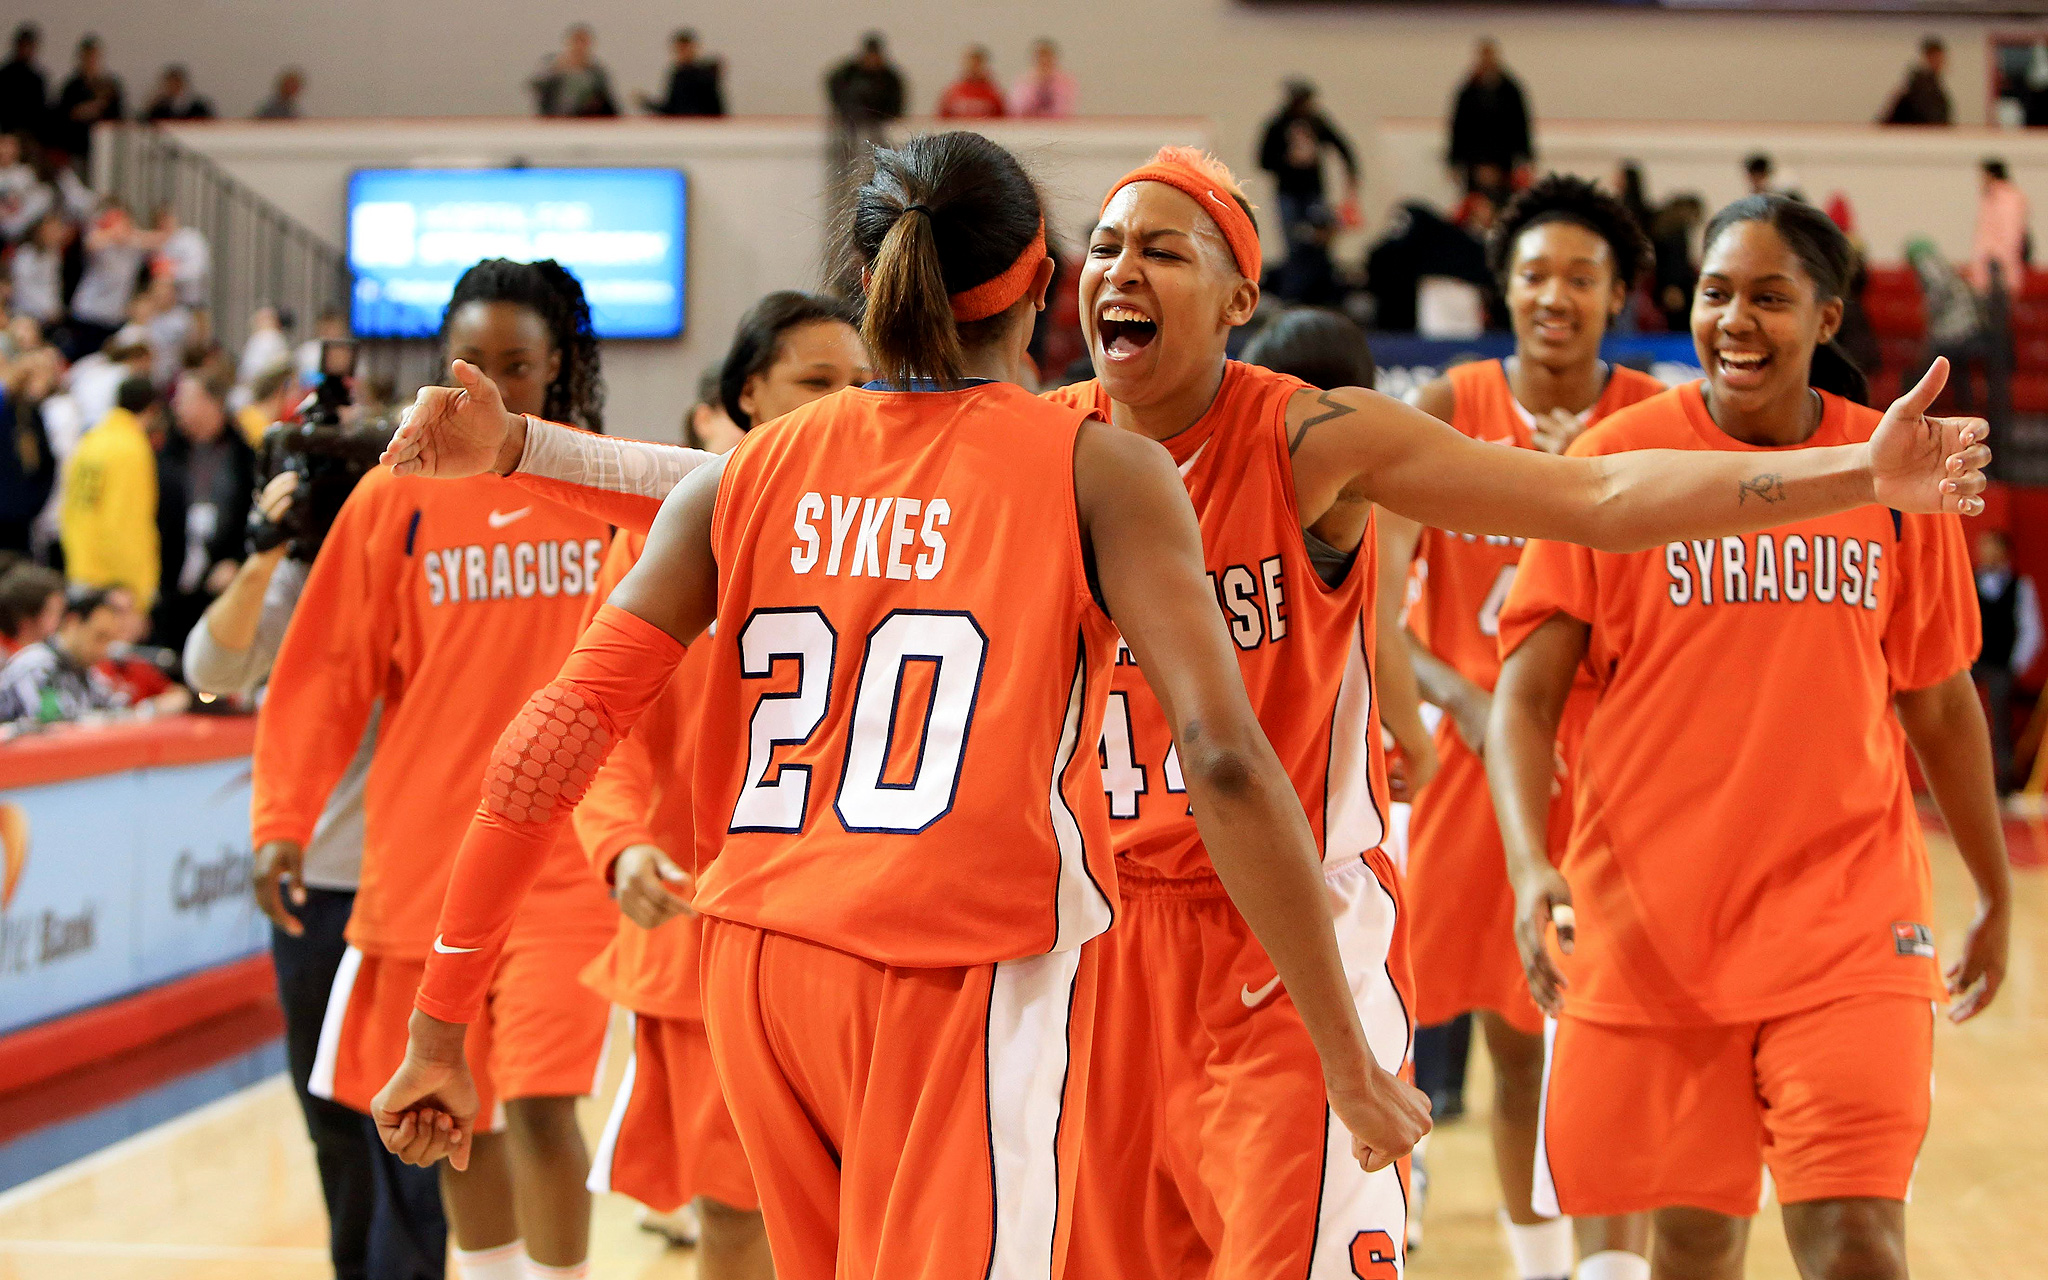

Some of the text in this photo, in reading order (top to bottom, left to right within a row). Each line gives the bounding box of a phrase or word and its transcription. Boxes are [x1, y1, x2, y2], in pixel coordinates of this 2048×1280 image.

[423, 538, 602, 606] SYRACUSE
[790, 491, 951, 580] SYKES
[1665, 533, 1882, 610] SYRACUSE
[727, 605, 989, 834] 20
